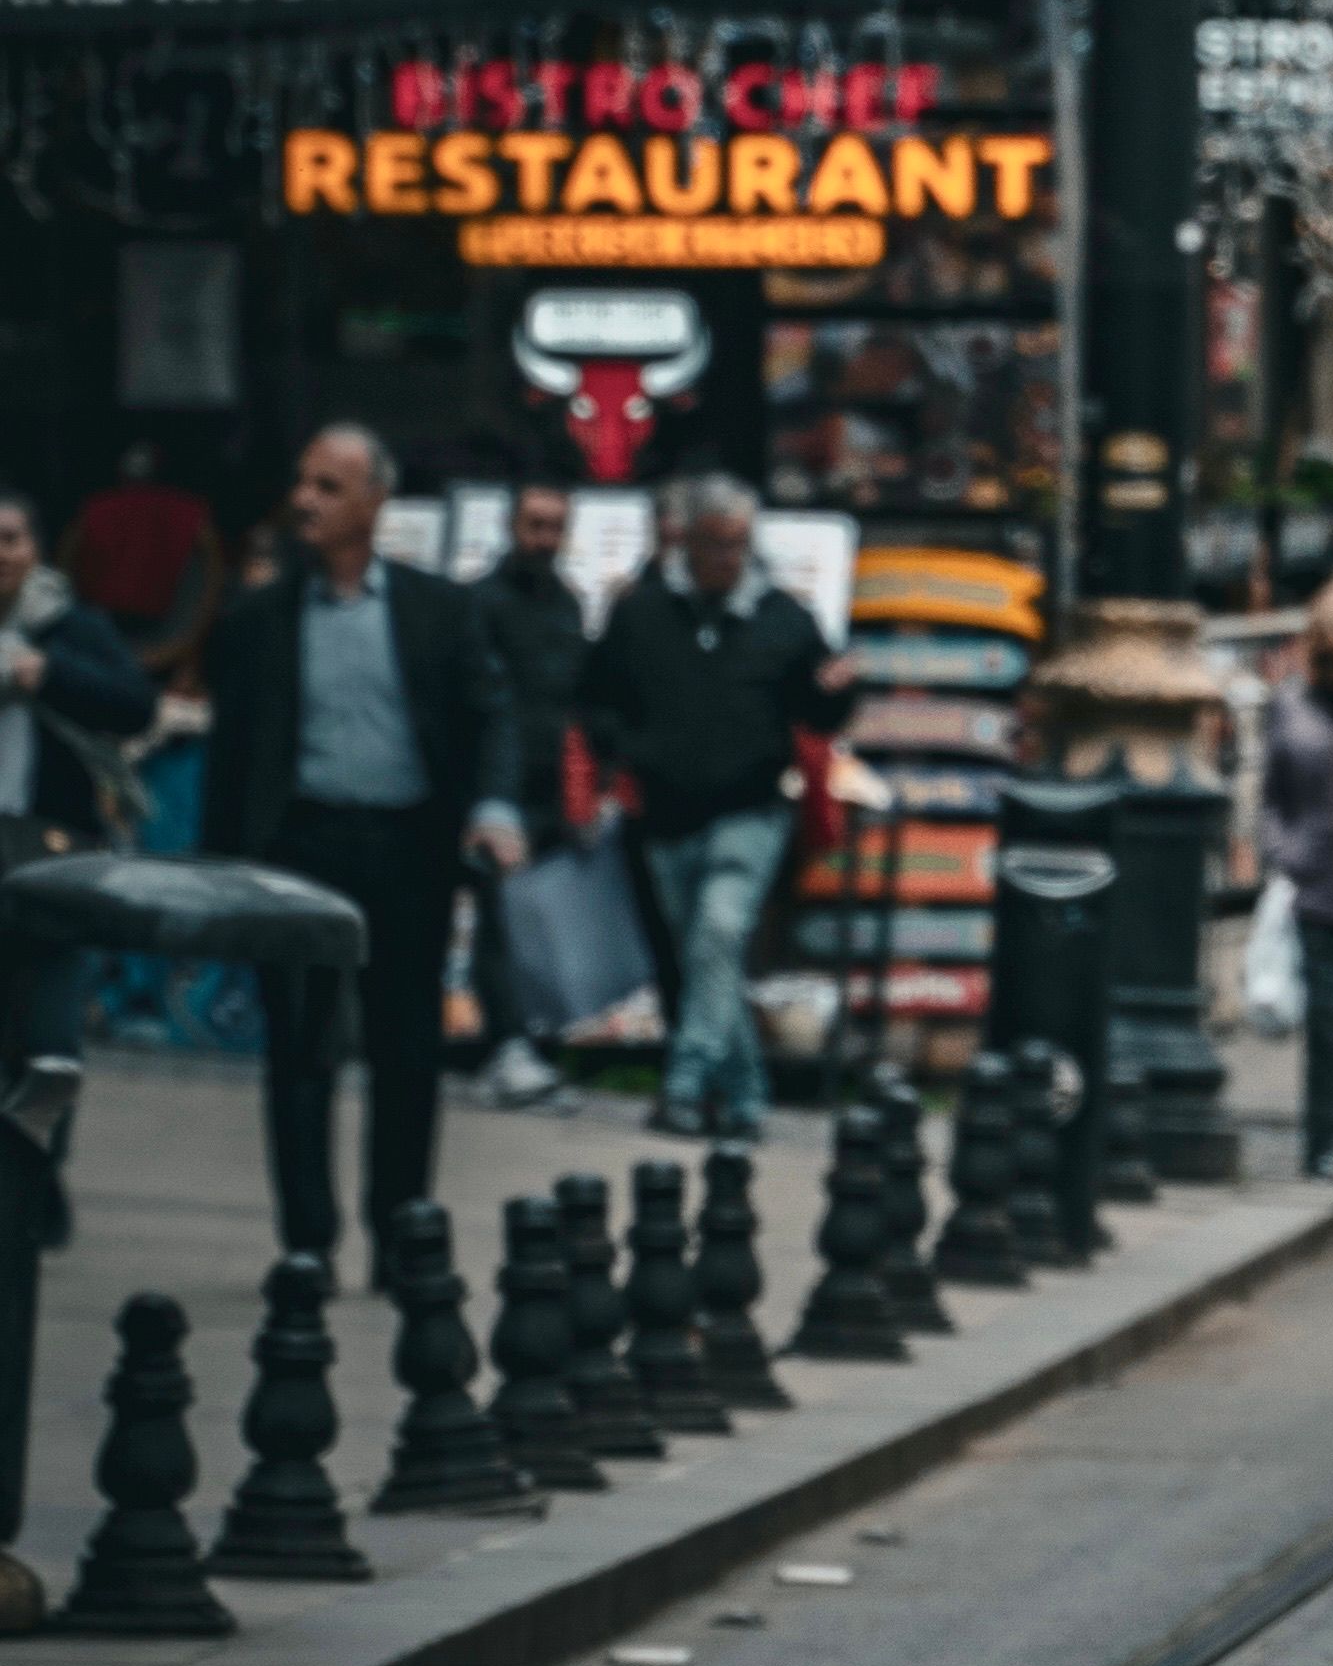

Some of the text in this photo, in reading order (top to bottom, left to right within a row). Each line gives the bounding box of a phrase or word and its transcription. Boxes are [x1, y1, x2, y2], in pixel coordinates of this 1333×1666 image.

[390, 60, 942, 134] BISTRO CHEF
[282, 127, 1054, 221] RESTAURANT
